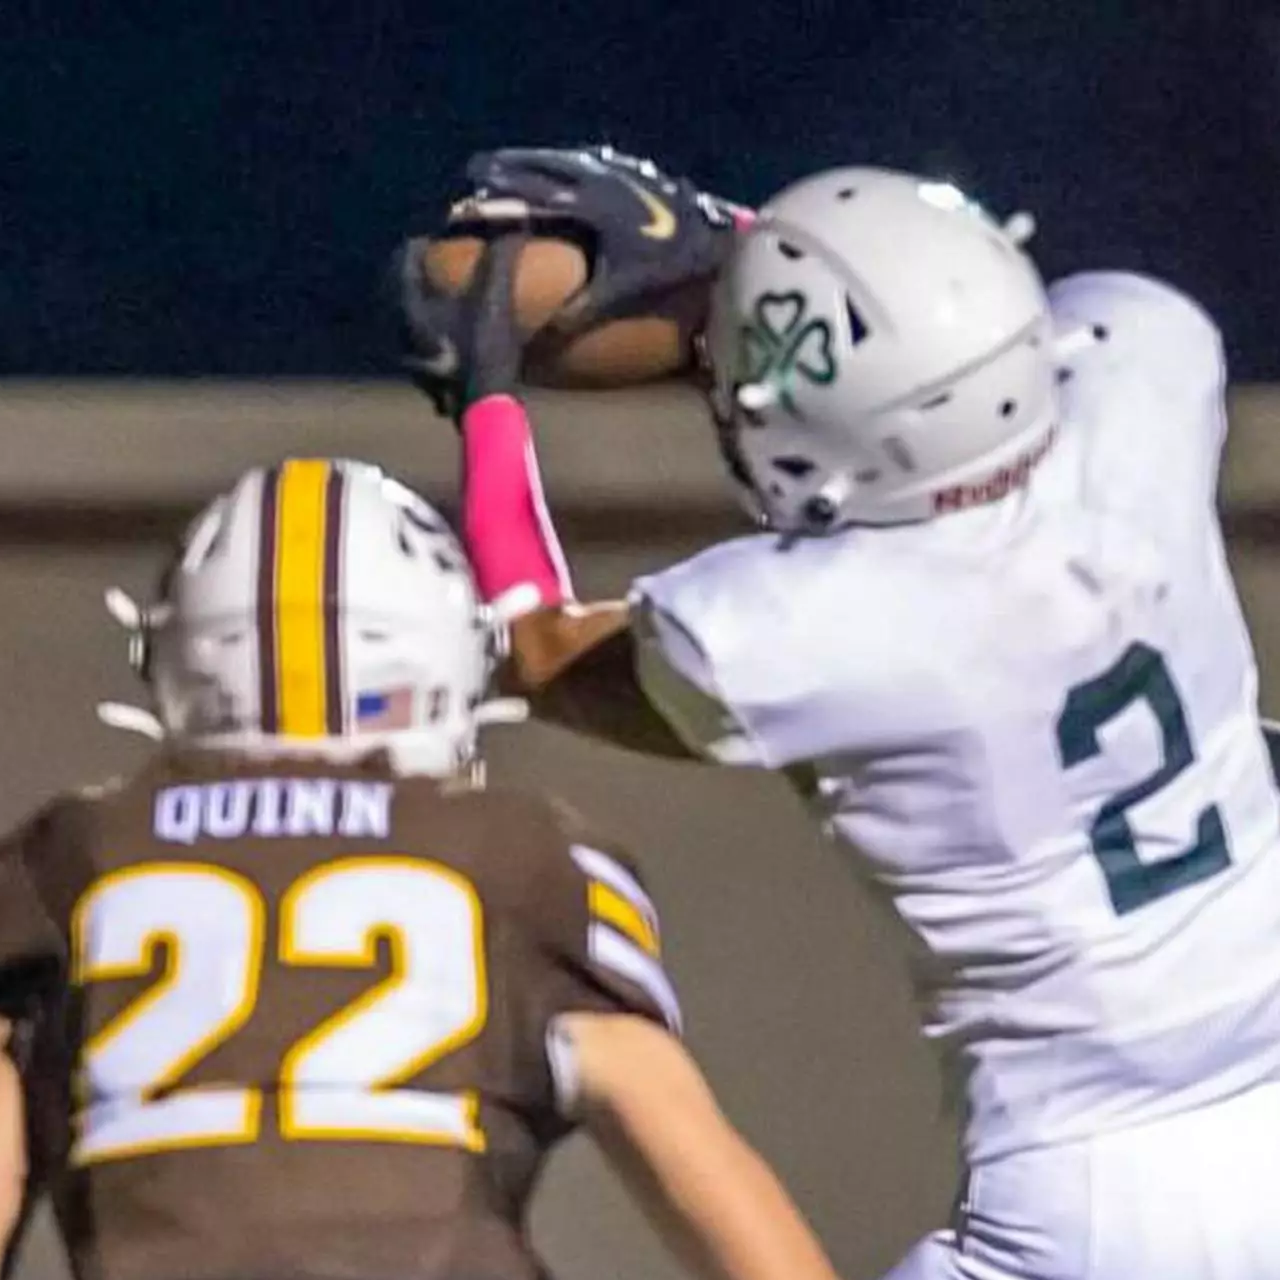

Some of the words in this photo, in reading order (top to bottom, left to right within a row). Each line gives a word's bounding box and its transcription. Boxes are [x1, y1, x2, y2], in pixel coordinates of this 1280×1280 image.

[154, 779, 392, 843] QUINN
[1055, 640, 1232, 916] 2
[71, 855, 488, 1166] 22
